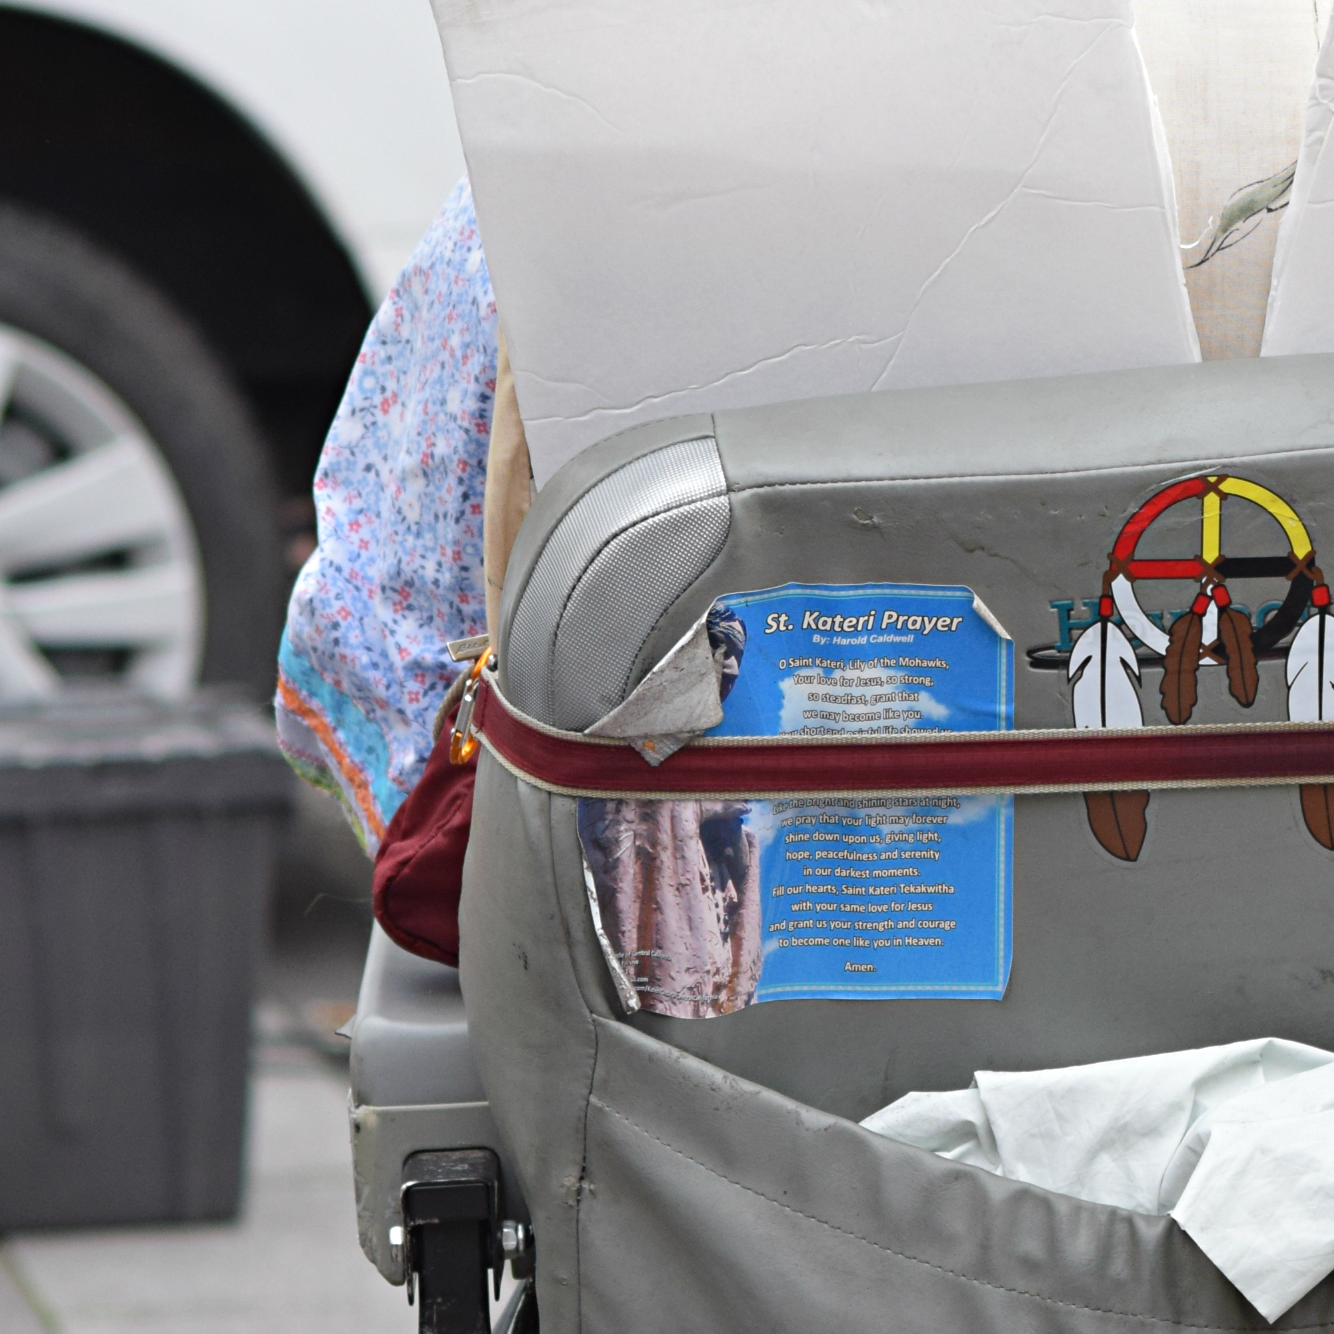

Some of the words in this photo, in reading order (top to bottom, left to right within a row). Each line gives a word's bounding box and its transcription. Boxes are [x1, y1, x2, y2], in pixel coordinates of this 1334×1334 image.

[764, 612, 794, 635] St.
[802, 610, 876, 634] Kateri
[880, 610, 962, 635] Prayer
[813, 635, 829, 644] By:
[833, 636, 867, 645] Harold
[869, 634, 914, 643] Caldwell
[789, 658, 813, 668] Saint
[815, 658, 846, 670] Kateri,
[849, 660, 865, 670] Lily
[868, 658, 878, 669] of
[880, 658, 896, 667] the
[899, 658, 949, 669] Mohawks,
[793, 675, 815, 685] Your
[817, 674, 837, 686] love
[839, 676, 854, 686] for
[856, 676, 884, 687] Jesus,
[886, 676, 898, 684] so
[900, 675, 934, 686] strong,
[808, 693, 820, 701] so
[822, 692, 868, 705] steadfast,
[870, 692, 896, 705] grant
[898, 691, 919, 702] that
[803, 711, 818, 719] we
[820, 711, 840, 723] may
[842, 710, 880, 722] become
[883, 708, 900, 718] like
[902, 710, 924, 720] you.
[773, 802, 788, 815] Like
[838, 798, 855, 808] and
[858, 798, 891, 809] shining
[894, 797, 917, 806] stars
[920, 796, 930, 806] at
[932, 796, 960, 808] night,
[781, 818, 793, 827] we
[796, 818, 815, 827] pray
[819, 814, 839, 824] that
[842, 817, 863, 826] your
[865, 815, 887, 827] light
[889, 816, 909, 826] may
[912, 814, 947, 824] forever
[785, 833, 810, 844] shine
[812, 832, 839, 841] down
[843, 835, 867, 844] upon
[870, 835, 883, 844] us,
[885, 833, 914, 844] giving
[916, 832, 941, 843] light,
[786, 851, 812, 861] hope,
[815, 850, 878, 861] peacefulness
[880, 850, 898, 859] and
[900, 850, 940, 860] serenity
[803, 867, 812, 876] in
[815, 868, 831, 876] our
[834, 867, 869, 878] darkest
[872, 868, 921, 877] moments.
[772, 886, 784, 898] Fill
[787, 886, 802, 894] our
[805, 884, 839, 895] hearts,
[841, 885, 866, 895] Saint
[868, 885, 897, 895] Kateri
[899, 883, 955, 894] Tekakwitha
[791, 901, 812, 911] with
[815, 903, 837, 912] your
[840, 903, 865, 913] same
[868, 903, 889, 912] love
[891, 902, 905, 910] for
[907, 902, 933, 911] Jesus
[769, 921, 786, 932] and
[788, 920, 813, 931] grant
[830, 920, 851, 930] your
[854, 920, 894, 931] strength
[897, 919, 916, 928] and
[918, 921, 956, 930] courage
[778, 938, 789, 947] to
[792, 937, 830, 946] become
[833, 938, 850, 946] one
[853, 937, 870, 947] like
[873, 938, 891, 949] you
[893, 937, 902, 946] in
[905, 937, 944, 946] Heaven.
[844, 962, 876, 972] Amen.
